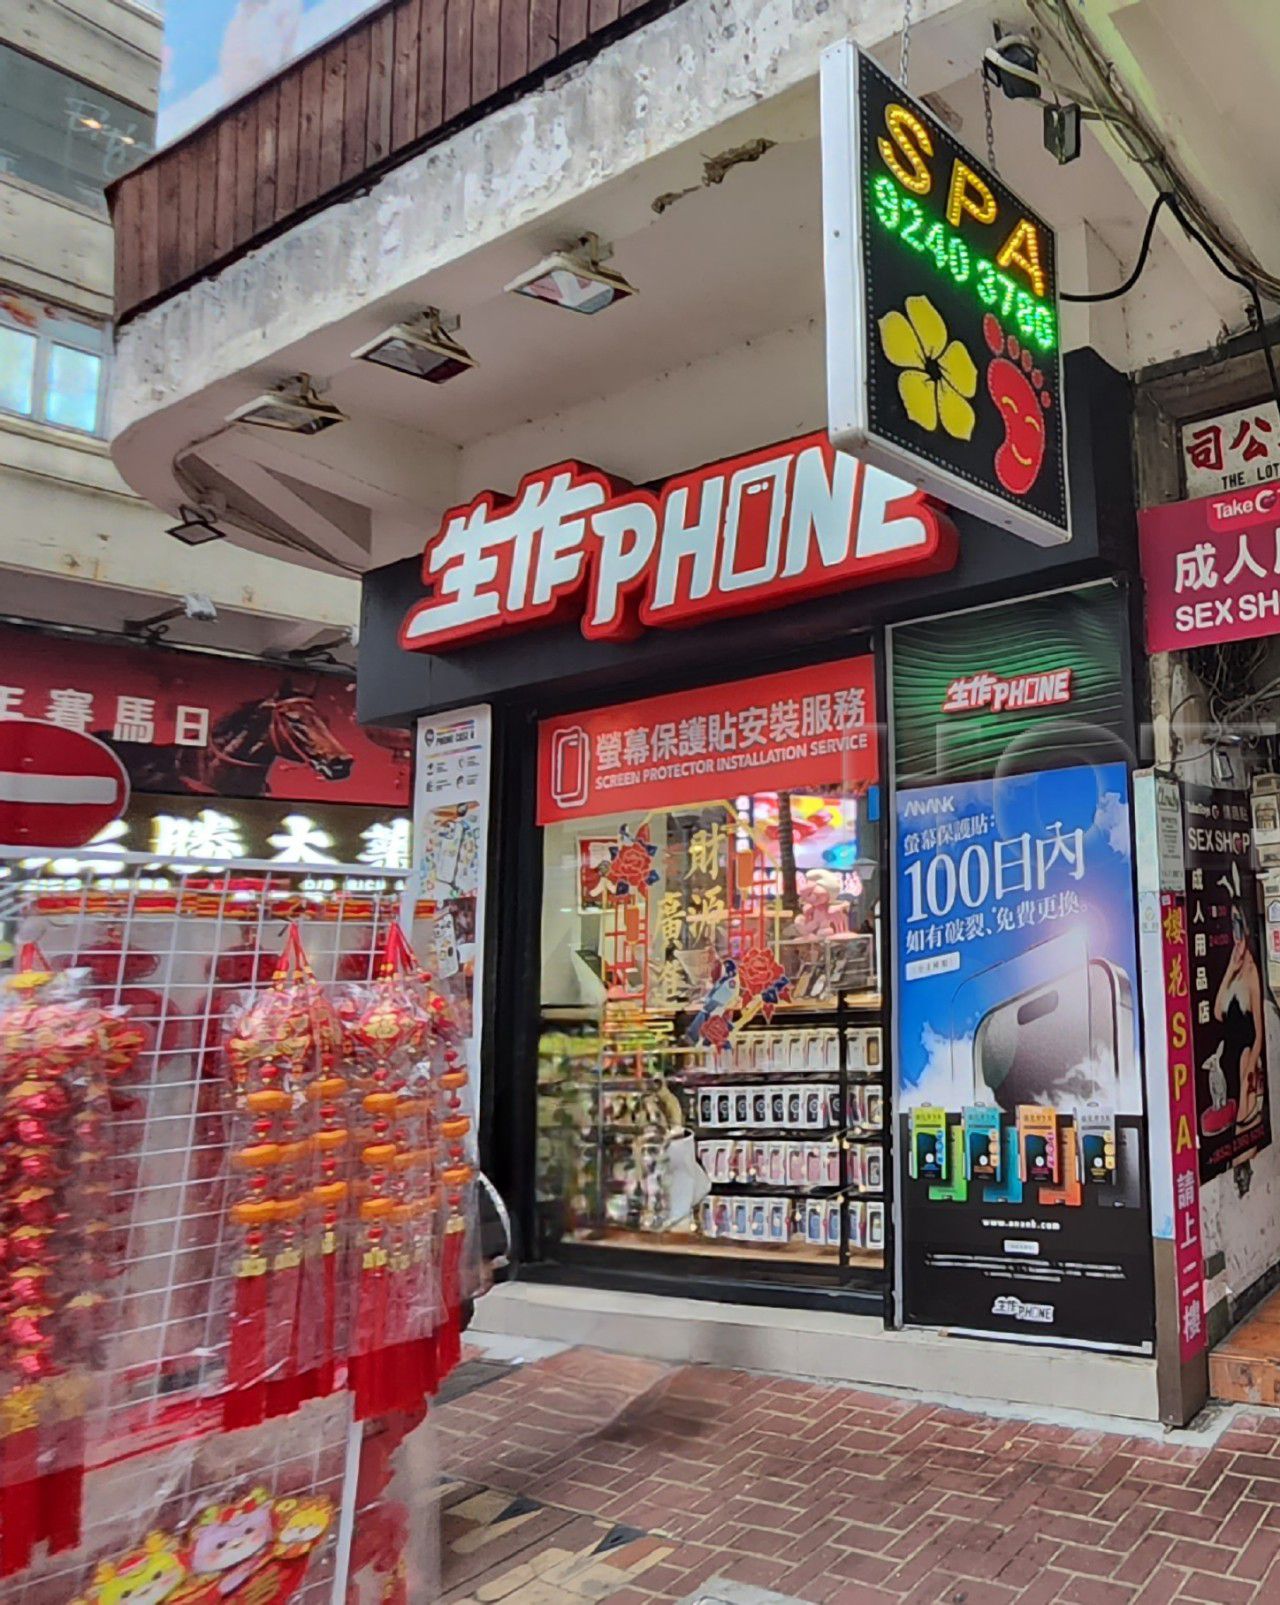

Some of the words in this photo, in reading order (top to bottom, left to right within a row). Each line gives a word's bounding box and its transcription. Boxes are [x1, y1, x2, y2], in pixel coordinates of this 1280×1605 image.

[873, 175, 971, 283] 9240
[877, 103, 1044, 298] SPA
[1212, 497, 1254, 519] Take
[1221, 472, 1246, 490] THE
[1175, 597, 1234, 633] SEX
[596, 687, 866, 772] 螢幕保護貼安裝服務
[595, 770, 641, 791] SCREEN
[642, 760, 714, 782] PROTECTOR
[716, 742, 808, 771] INSTALLATION
[809, 733, 868, 757] SERVICE
[1187, 827, 1214, 853] SEX
[1215, 829, 1251, 855] SHOP
[903, 820, 1086, 924] 100日內
